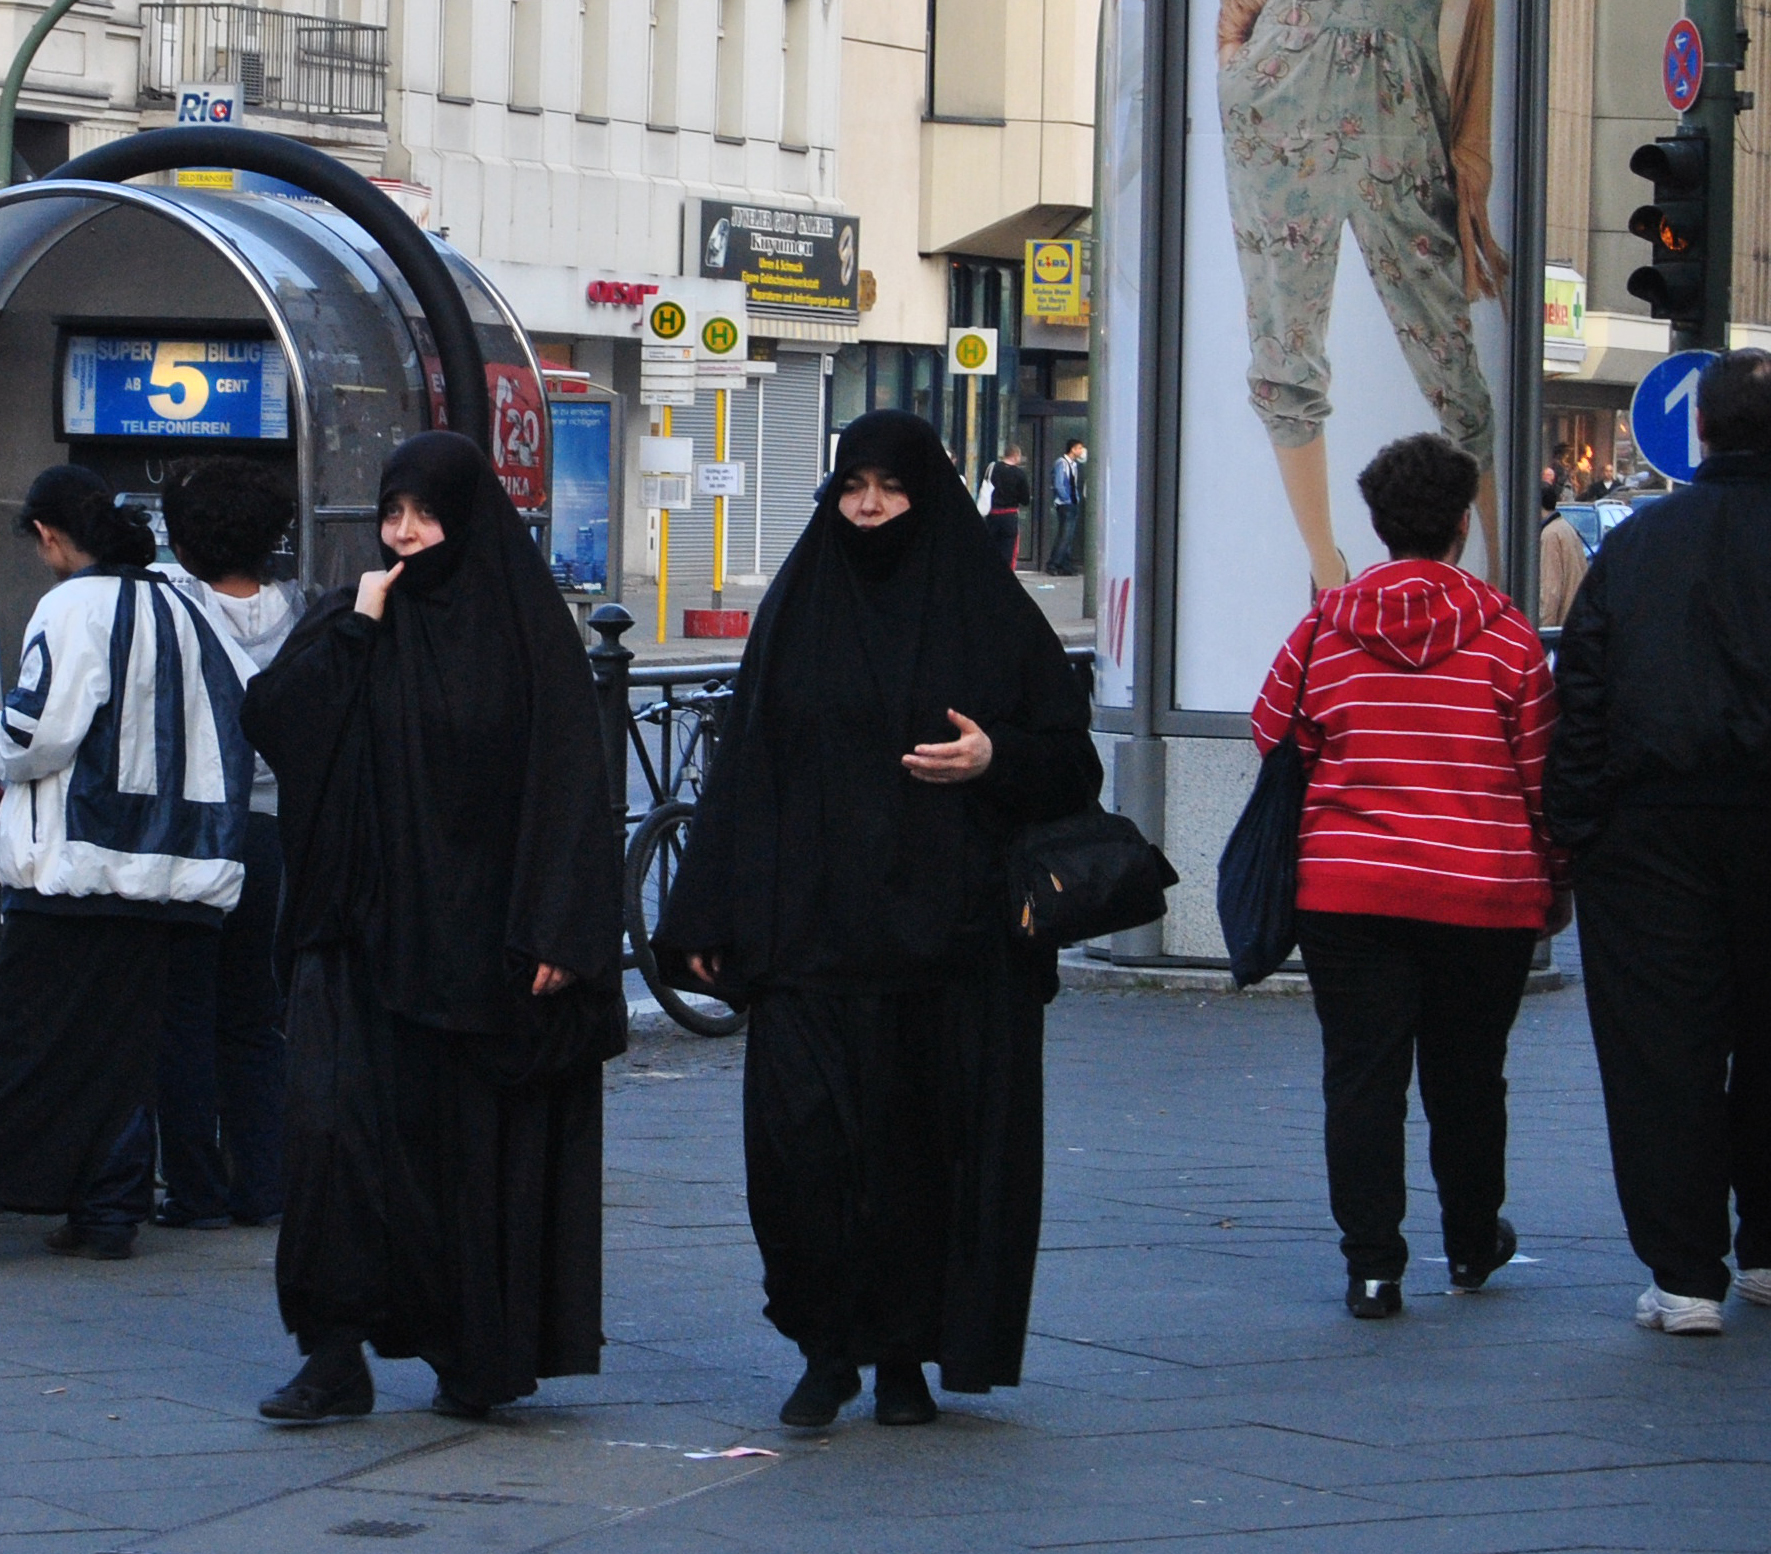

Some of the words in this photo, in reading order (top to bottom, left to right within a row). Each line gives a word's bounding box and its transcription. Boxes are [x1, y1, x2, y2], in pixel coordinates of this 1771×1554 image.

[178, 91, 234, 122] Ria
[178, 172, 233, 183] GELDTRANSFER
[773, 211, 797, 234] GOLD
[797, 214, 834, 238] GALERIE
[750, 232, 814, 257] Kuyumcu
[659, 310, 676, 331] H
[711, 326, 728, 346] H
[97, 340, 153, 361] SUPER
[207, 342, 262, 363] BILLIG
[964, 342, 979, 360] H
[124, 377, 142, 391] AB
[147, 341, 210, 421] 5
[215, 378, 250, 393] CENT
[120, 419, 231, 435] TELEFONIEREN
[506, 408, 540, 452] 20
[498, 475, 530, 496] RIKA
